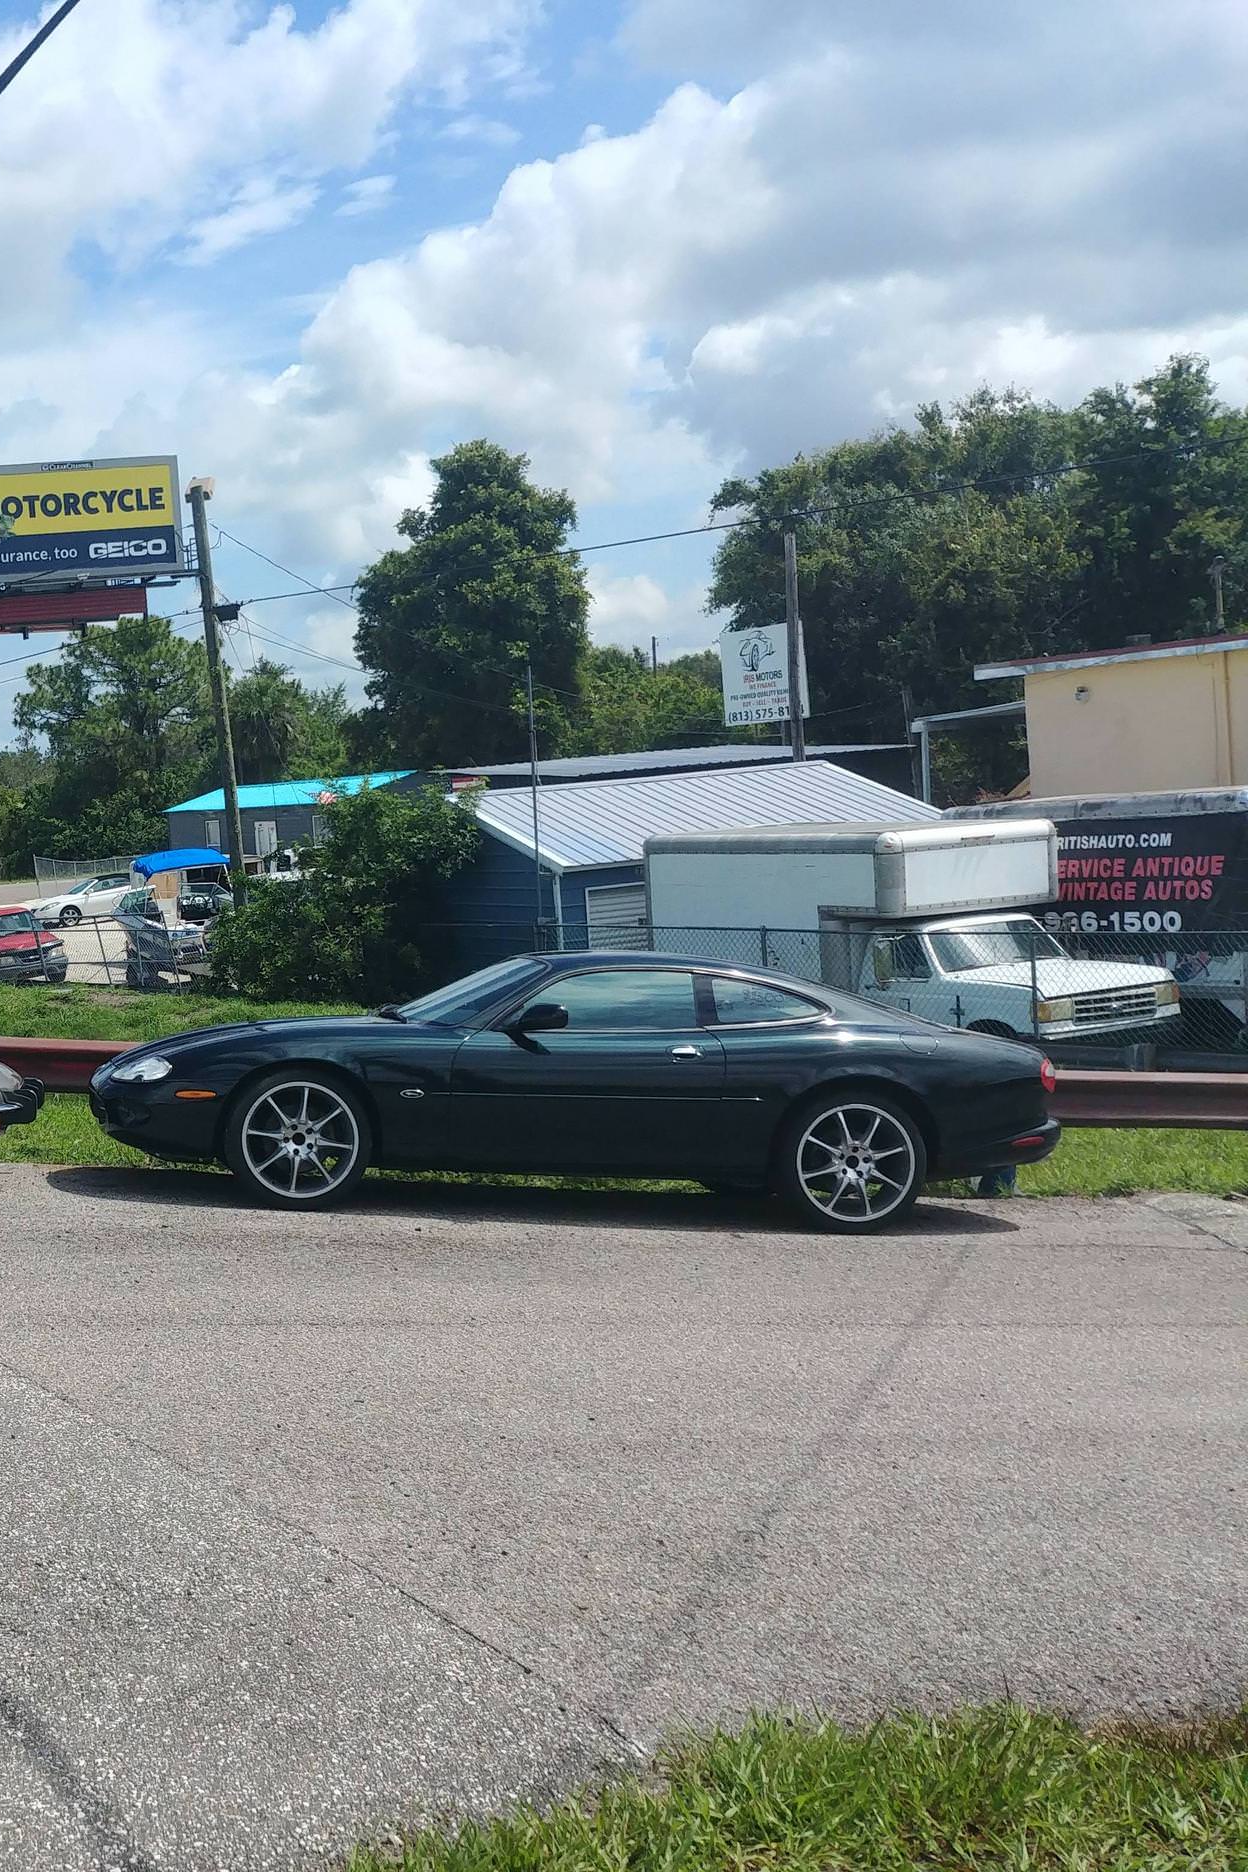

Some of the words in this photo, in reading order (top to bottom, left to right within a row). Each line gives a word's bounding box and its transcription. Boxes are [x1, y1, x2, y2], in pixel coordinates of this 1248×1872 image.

[54, 547, 78, 560] too
[89, 538, 168, 560] GEICO
[755, 670, 783, 681] MOTORS
[728, 710, 753, 724] (813)
[1132, 855, 1226, 877] ANTIQUE
[1143, 879, 1214, 901] AUTOS
